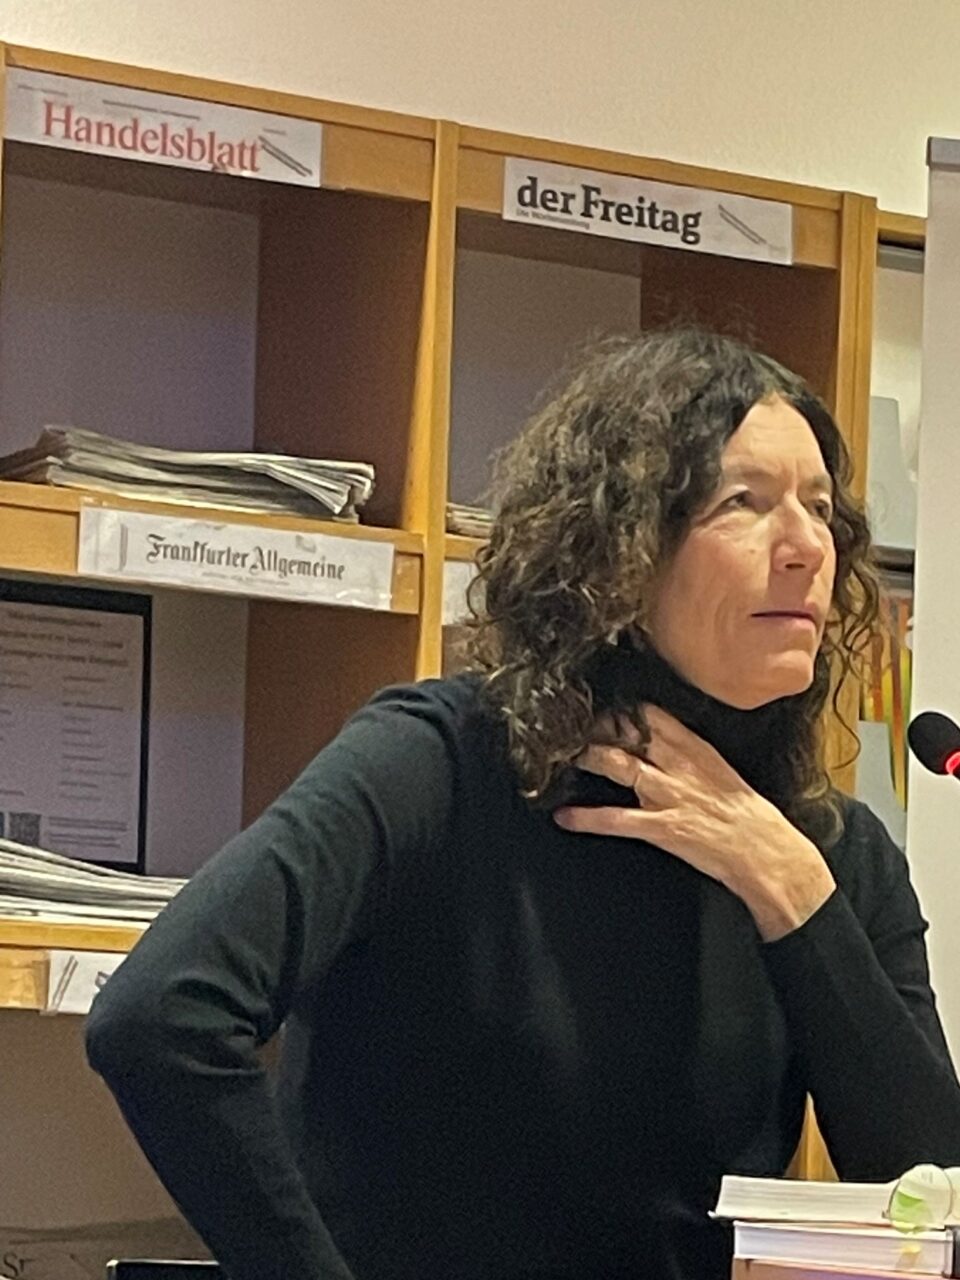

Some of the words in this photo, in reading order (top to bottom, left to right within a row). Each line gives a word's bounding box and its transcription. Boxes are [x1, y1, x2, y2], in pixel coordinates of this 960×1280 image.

[42, 98, 260, 173] Handelsblatt
[517, 176, 576, 216] der
[580, 184, 702, 245] Freitag
[145, 533, 250, 570] Frankfurter
[249, 545, 346, 581] Allgemeine
